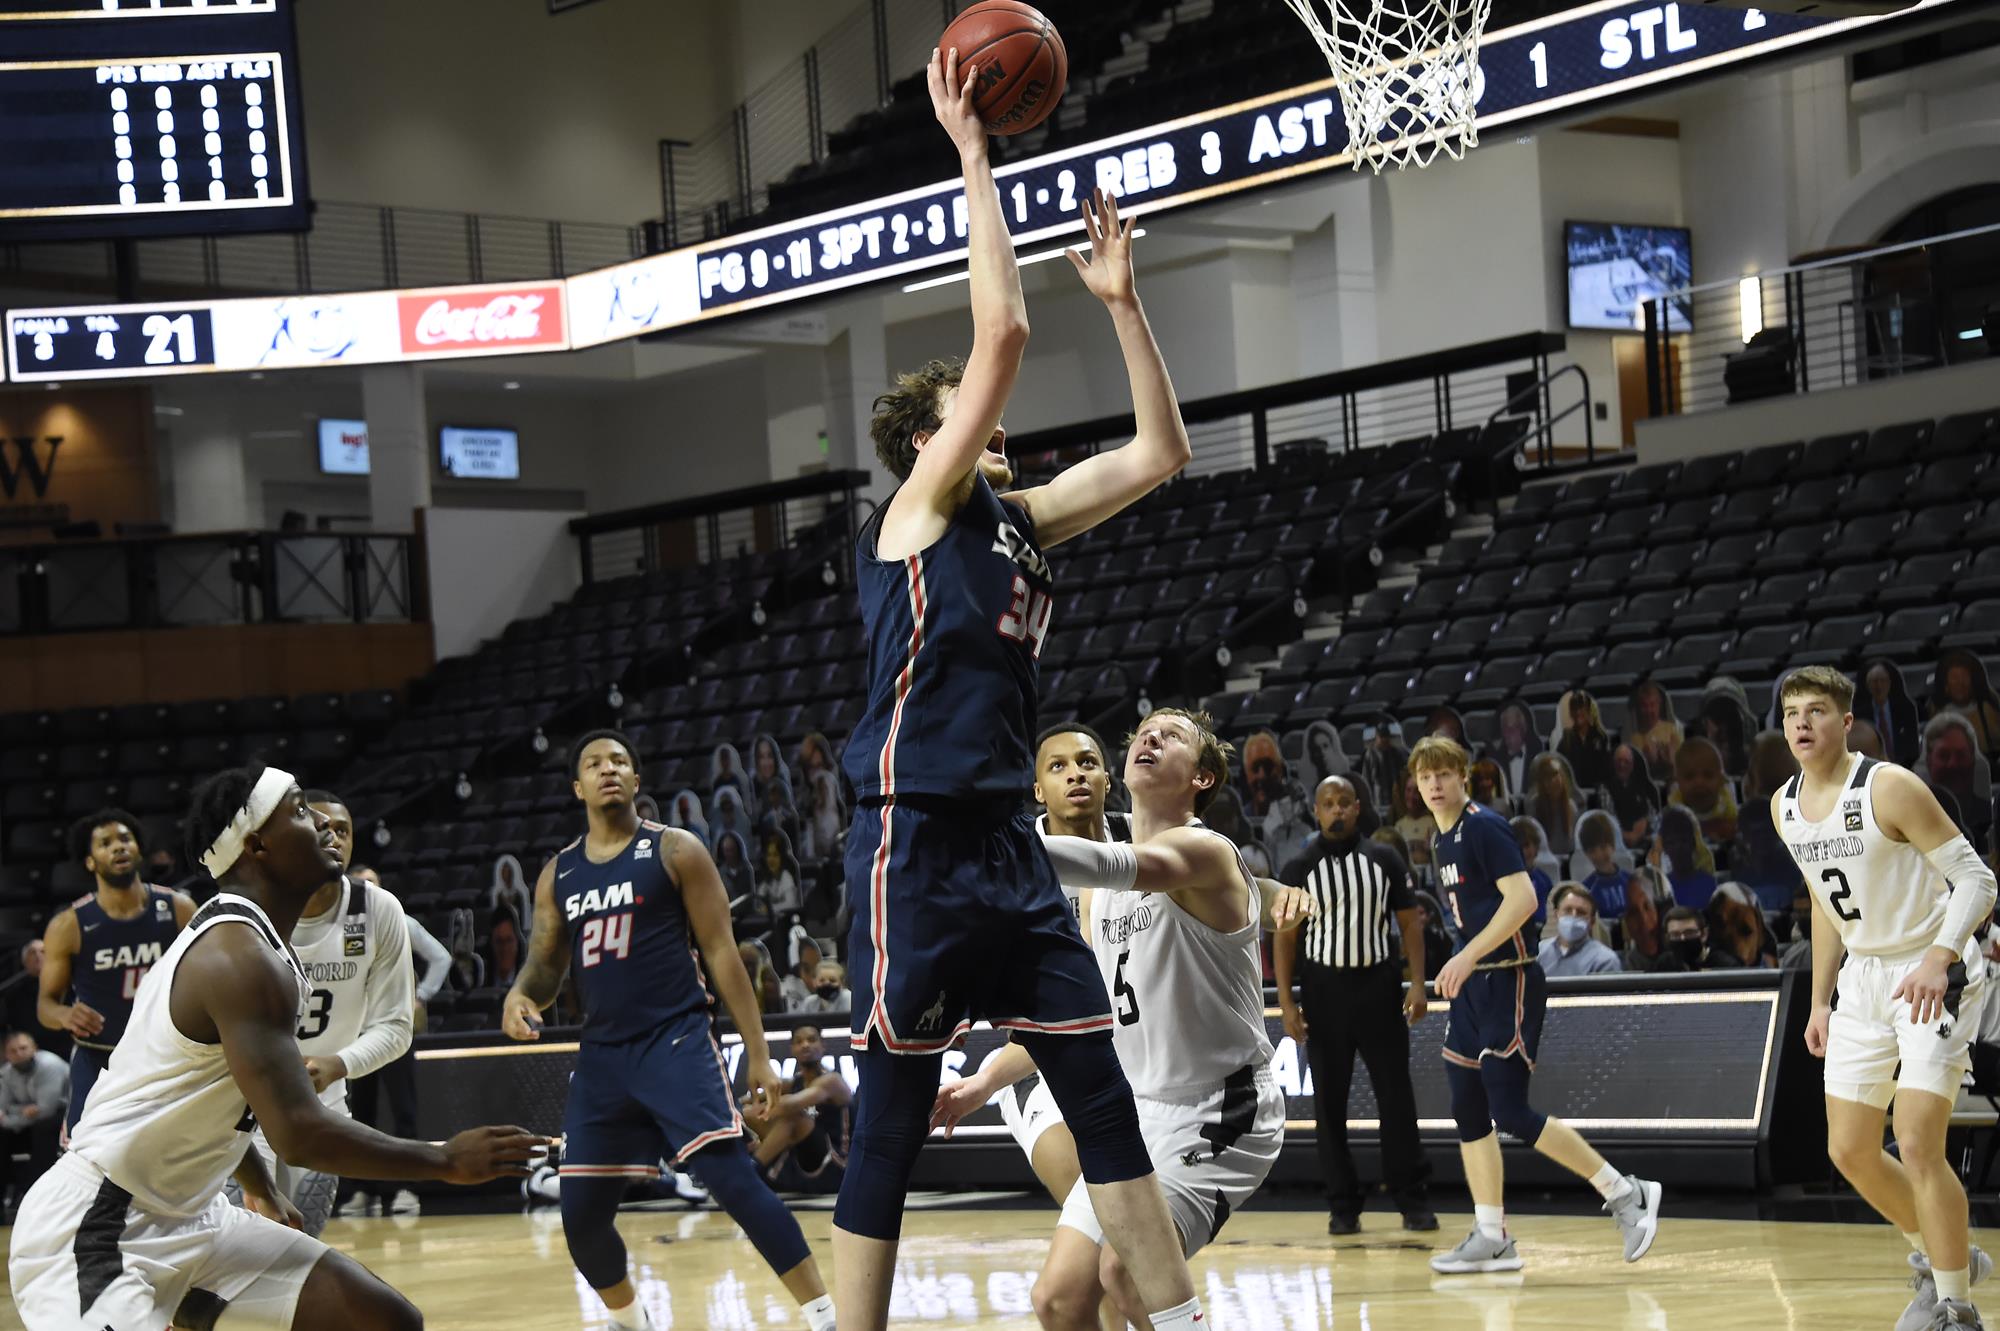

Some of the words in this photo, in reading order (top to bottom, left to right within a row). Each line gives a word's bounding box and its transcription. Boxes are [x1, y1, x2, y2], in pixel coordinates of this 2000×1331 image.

[186, 62, 228, 80] AST
[699, 252, 746, 299] FG
[819, 216, 885, 269] 3PT
[1095, 142, 1177, 199] REB
[1248, 98, 1333, 163] AST
[1529, 42, 1548, 89] 1
[1600, 2, 1697, 69] STL
[142, 314, 196, 364] 21
[996, 573, 1053, 660] 34
[1790, 836, 1864, 863] WOFFORD
[1821, 868, 1862, 922] 2
[581, 912, 634, 969] 24
[1113, 950, 1140, 1027] 5
